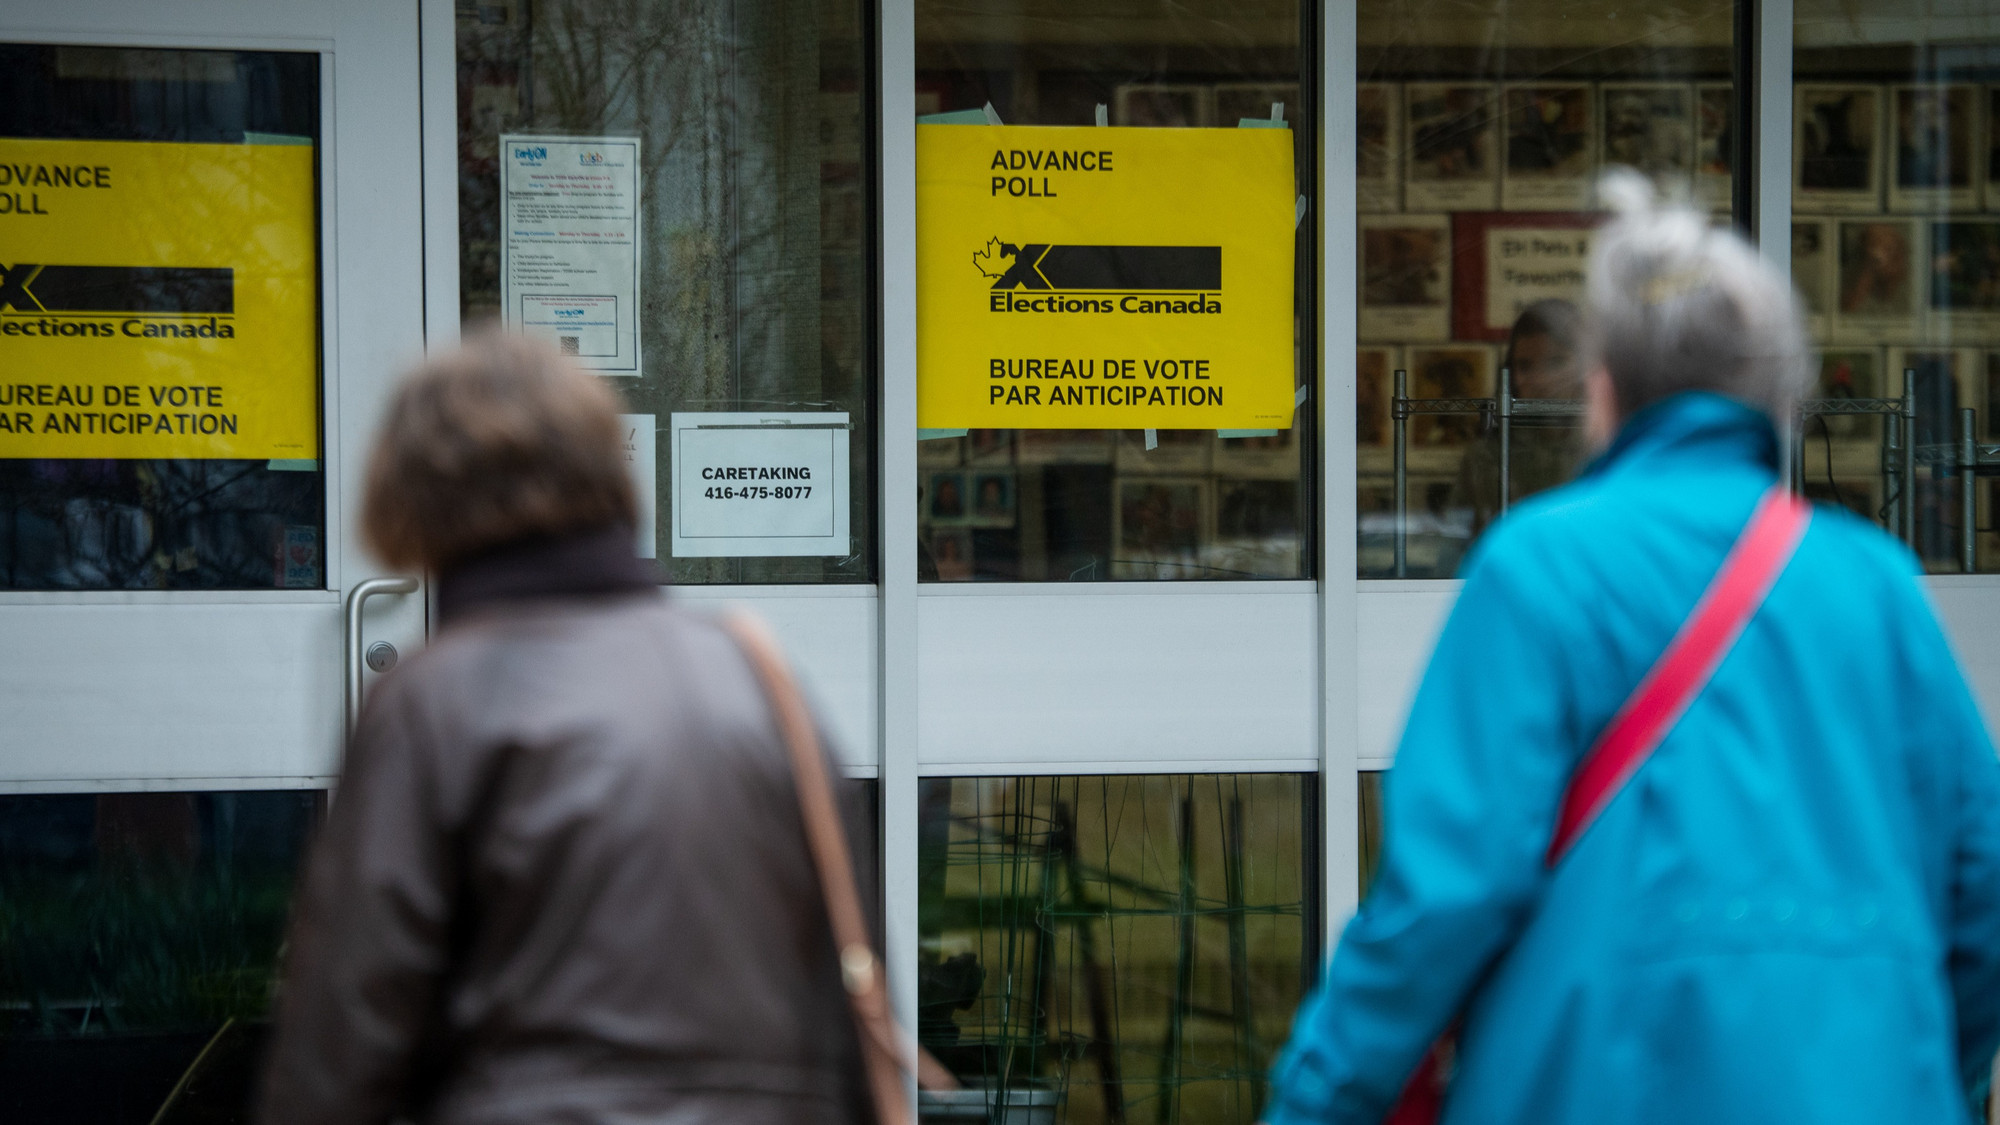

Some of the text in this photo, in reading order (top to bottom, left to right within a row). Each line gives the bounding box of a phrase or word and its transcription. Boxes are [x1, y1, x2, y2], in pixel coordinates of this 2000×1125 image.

[990, 150, 1113, 172] ADVANCE
[0, 163, 111, 188] DVANCE
[991, 176, 1057, 198] POLL
[0, 192, 49, 215] OLL
[990, 292, 1222, 315] Elections Canada
[0, 316, 235, 339] ections Canada
[990, 359, 1210, 380] BUREAU DE VOTE
[0, 384, 223, 408] UREAU DE VOTE
[990, 386, 1223, 407] PAR ANTICIPATION
[0, 412, 238, 435] AR ANTICIPATION
[701, 466, 811, 480] CARETAKING
[704, 486, 812, 500] 416-475-8077
